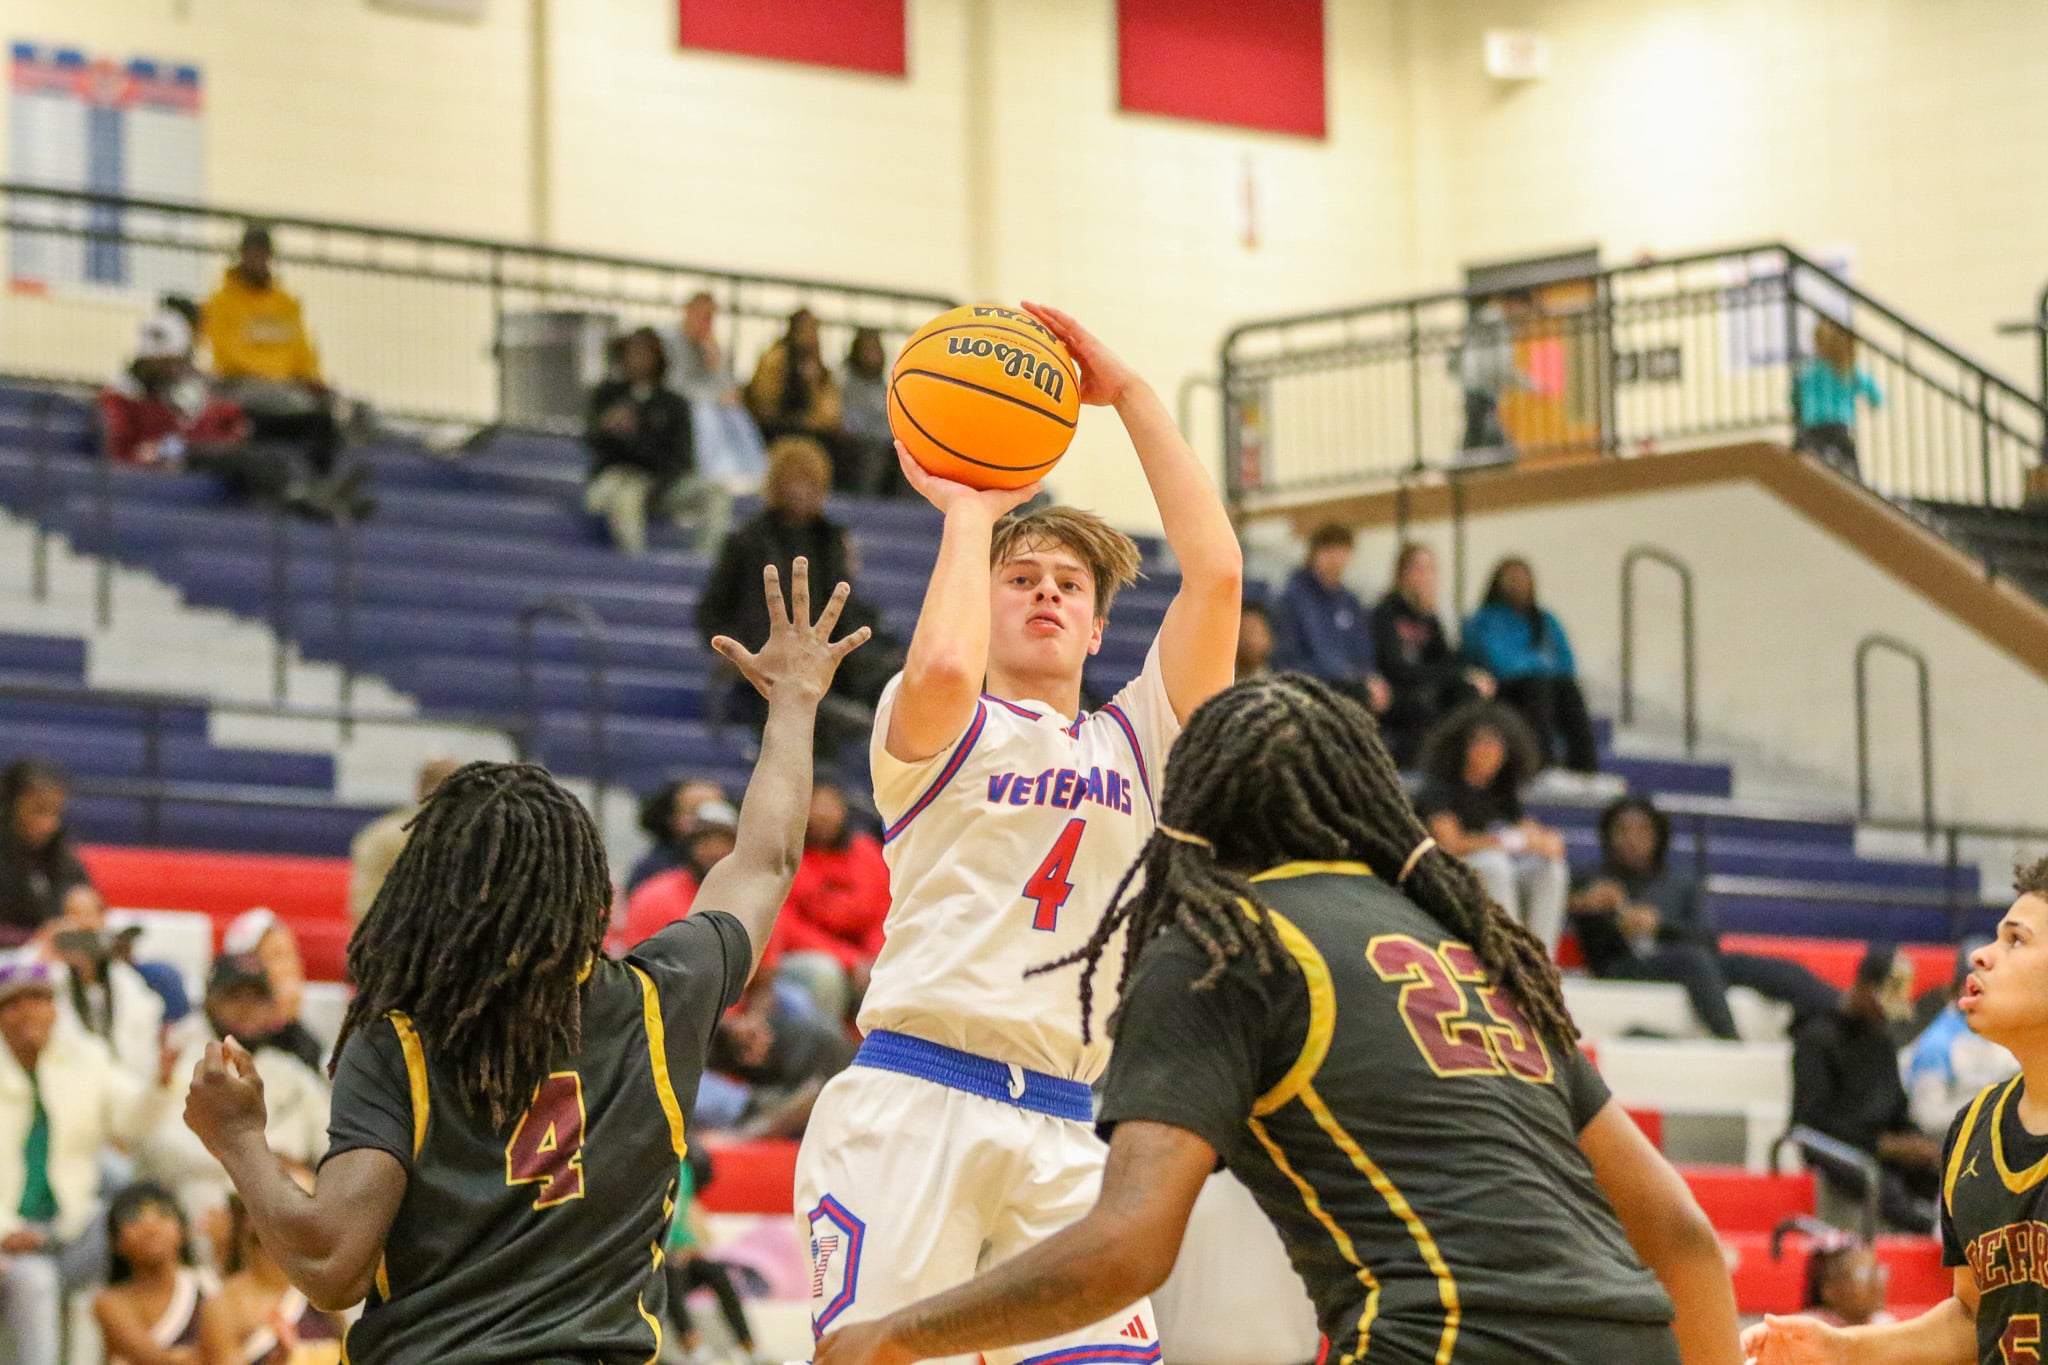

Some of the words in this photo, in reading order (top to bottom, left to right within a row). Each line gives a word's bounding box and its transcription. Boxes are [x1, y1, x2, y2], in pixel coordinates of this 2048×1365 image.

[947, 336, 1065, 405] Wilson
[973, 306, 1059, 346] NCAA
[1021, 817, 1087, 933] 4
[1364, 933, 1555, 1085] 23
[504, 1070, 587, 1211] 4
